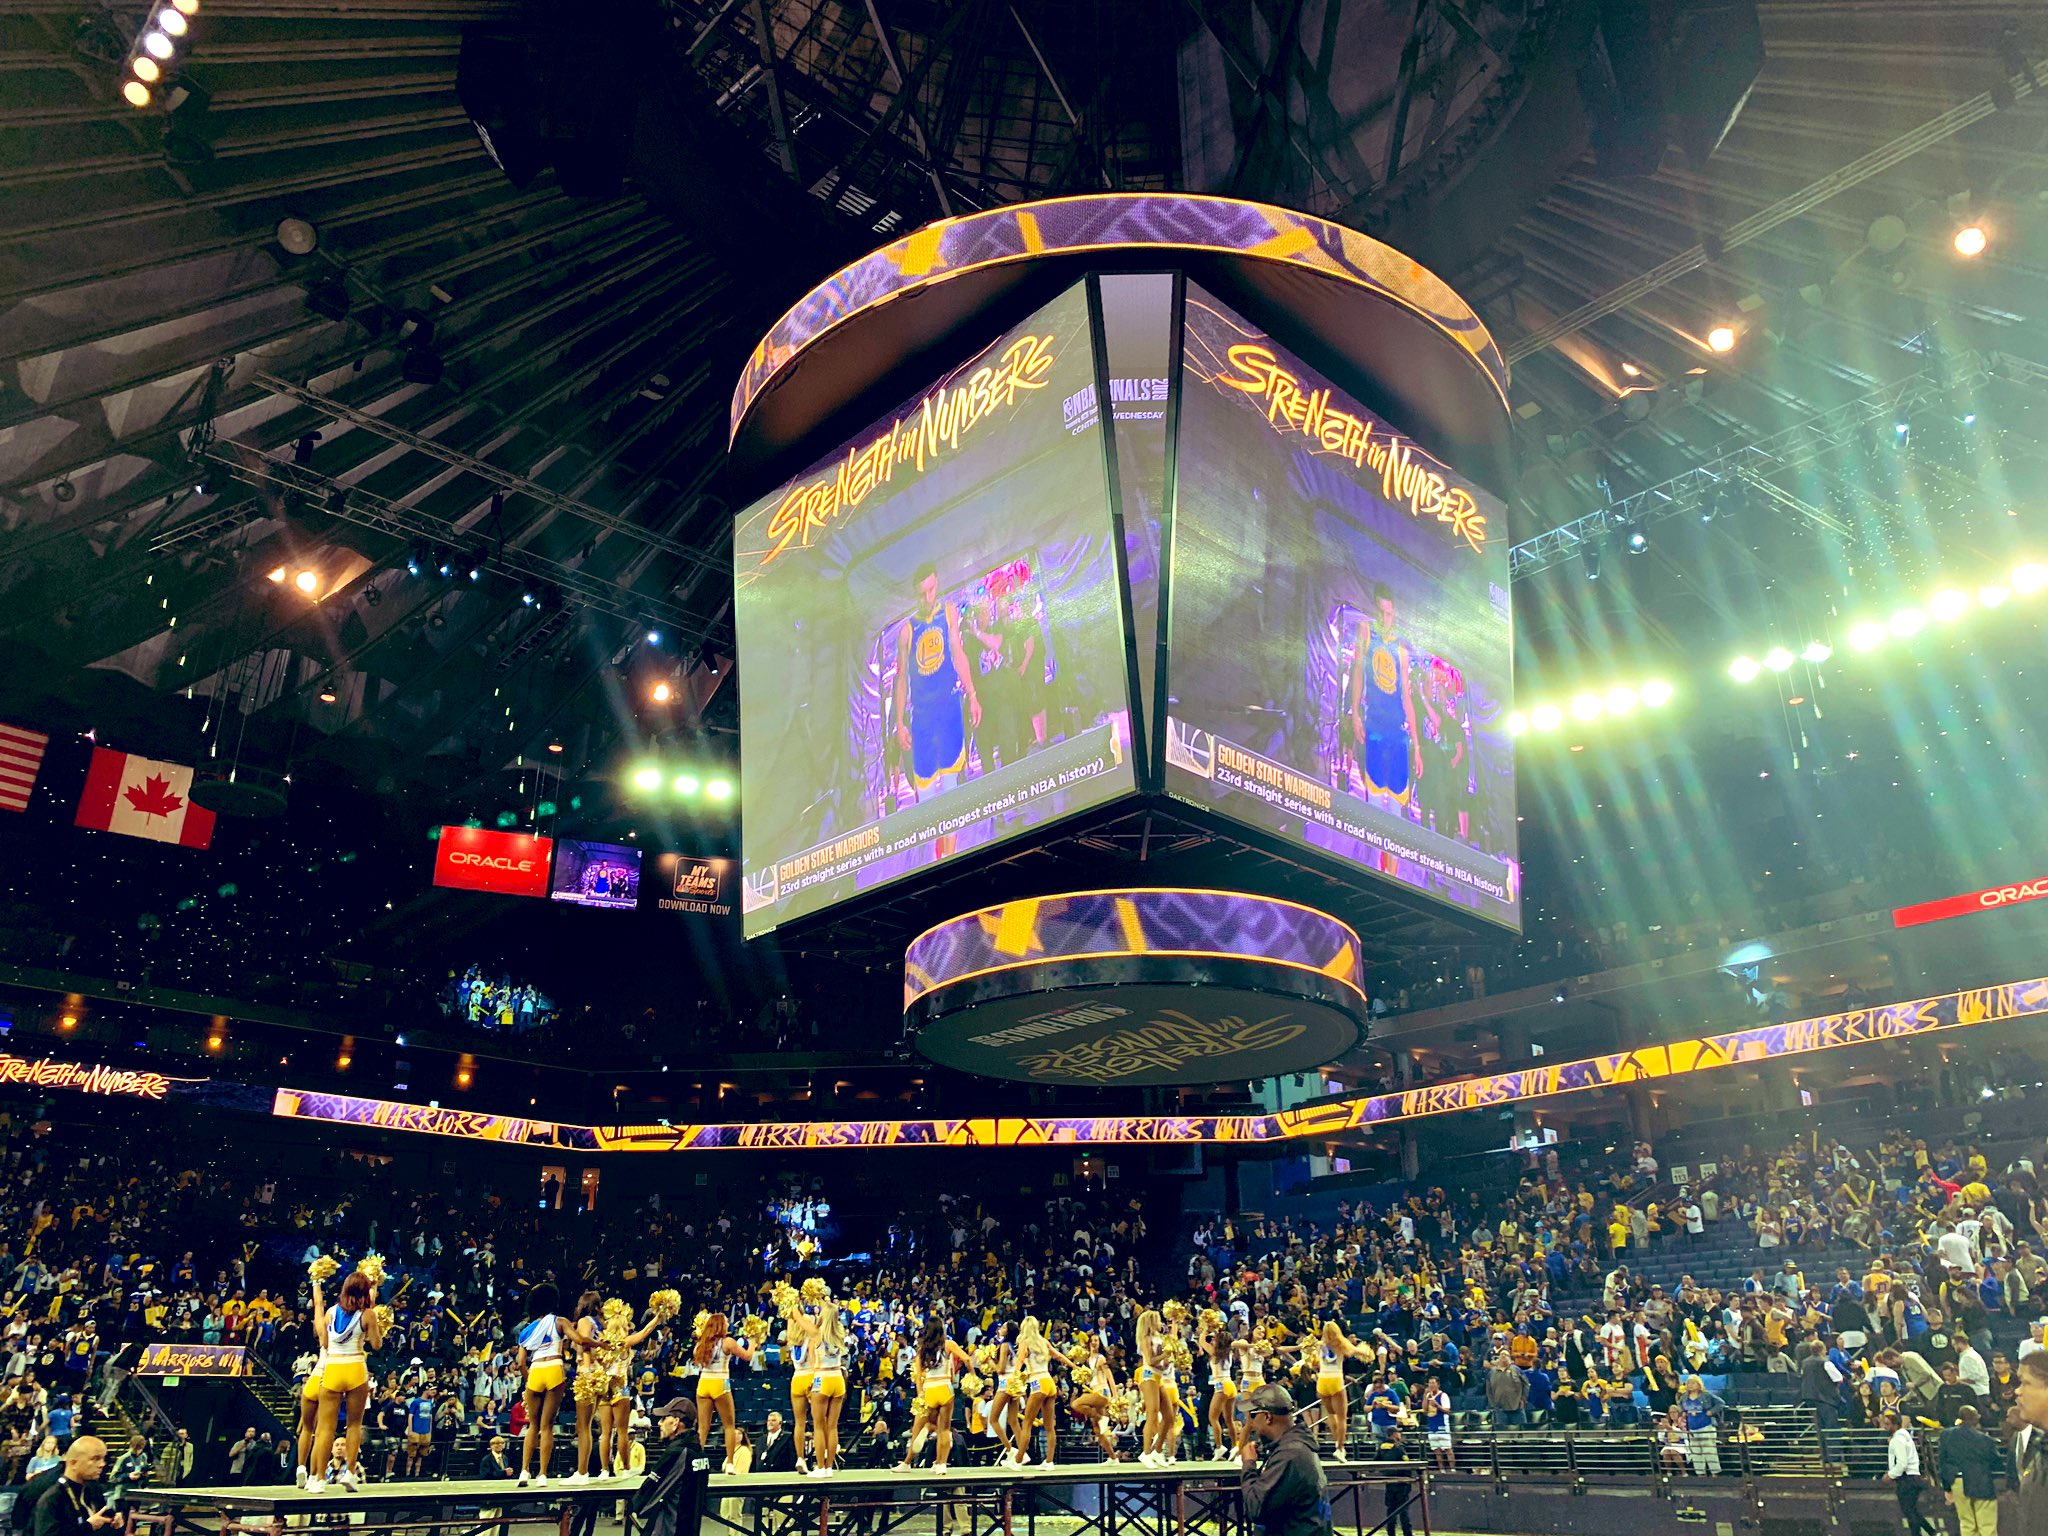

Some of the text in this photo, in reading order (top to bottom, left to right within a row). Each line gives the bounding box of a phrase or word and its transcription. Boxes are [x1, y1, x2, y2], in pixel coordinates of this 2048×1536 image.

[1072, 378, 1151, 417] NBA INALS
[760, 334, 1054, 565] STRENGTH in NUMBERS
[1216, 343, 1487, 554] STRENGTH in NUMBERS
[1217, 743, 1331, 809] GOLDEN STATE WARRIORS
[1168, 791, 1210, 813] DAKTRONICS
[780, 757, 1104, 896] 23rd straight series with a road win (longest streak in NBA history)
[1217, 767, 1504, 898] 23rd straight series with a road win (longest streak in NBA history)
[449, 852, 534, 873] ORACLE
[691, 865, 709, 877] MY
[779, 826, 880, 882] GOLDEN STATE WARRIORS
[680, 875, 716, 889] TEAMS
[1980, 880, 2048, 906] ORAC
[658, 898, 731, 916] DOWNLOAD NOW
[746, 925, 777, 941] DAKTRONICS
[1784, 986, 2016, 1051] WARRIORS WIN
[82, 1063, 170, 1100] NUMBERS
[1401, 1077, 1510, 1116] WARRIRS
[372, 1103, 533, 1142] WARRIORS WIN
[738, 1123, 850, 1146] WARRIRS
[1089, 1117, 1255, 1141] WARRIORS WIN
[152, 1351, 215, 1368] WARRIORS
